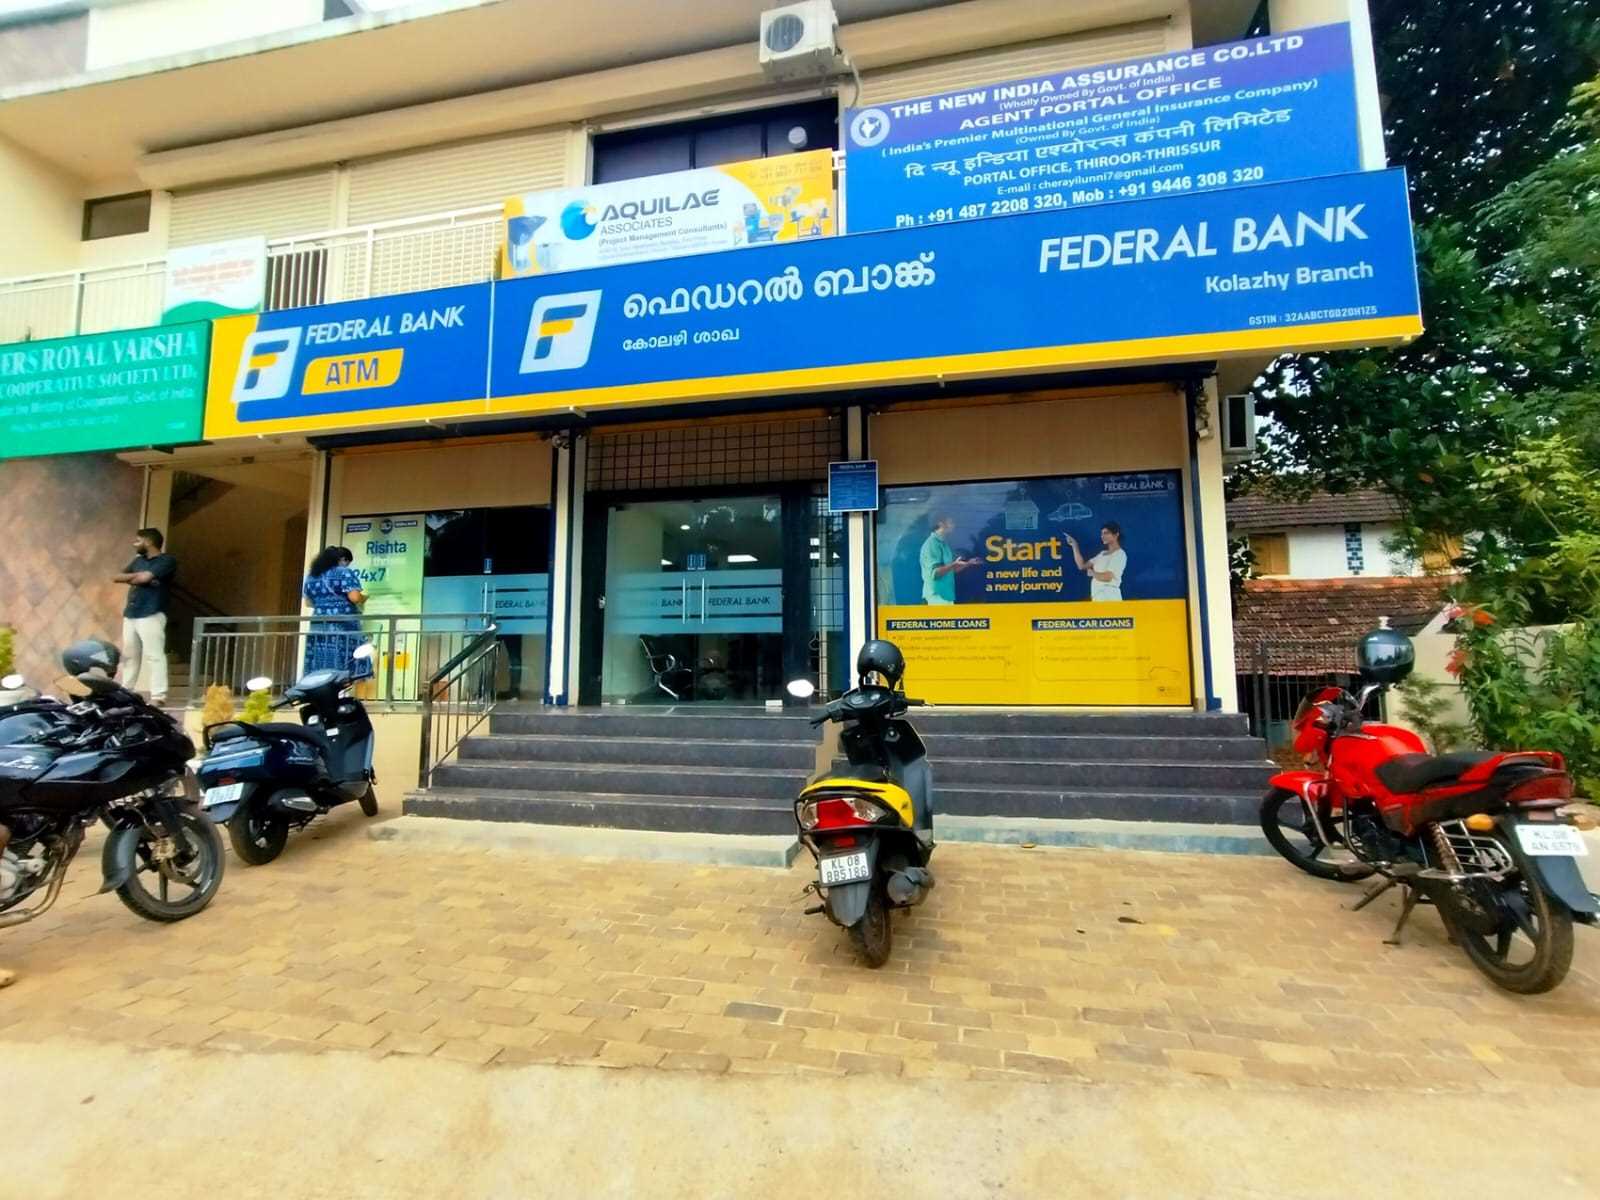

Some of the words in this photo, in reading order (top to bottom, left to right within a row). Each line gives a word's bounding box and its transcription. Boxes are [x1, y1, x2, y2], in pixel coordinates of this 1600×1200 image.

[891, 101, 933, 119] THE
[938, 91, 987, 111] NEW
[993, 80, 1055, 102] INDIA
[1061, 52, 1206, 90] ASSURANCE
[1213, 34, 1304, 63] CO.LTD
[959, 108, 1034, 130] AGENT
[1040, 93, 1130, 117] PORTAL
[1136, 77, 1222, 100] OFFICE
[999, 96, 1039, 112] (Wholly
[1041, 90, 1079, 104] Owned
[1082, 88, 1096, 98] By
[1098, 82, 1127, 94] Govt.
[1128, 77, 1141, 89] of
[1142, 73, 1175, 87] India)
[935, 133, 987, 149] Premier
[992, 116, 1088, 139] Multinational
[1092, 106, 1150, 125] General
[1155, 94, 1231, 113] Insurance
[1235, 78, 1318, 100] Company)
[1134, 120, 1196, 144] कंपनी
[1203, 107, 1295, 134] लिमिटेड
[1016, 131, 1060, 145] (Owned
[1062, 129, 1076, 139] By
[1079, 124, 1109, 135] Govt.
[1111, 120, 1125, 130] of
[1126, 115, 1160, 129] India)
[963, 165, 1016, 187] PORTAL
[1019, 161, 1073, 179] OFFICE,
[1075, 139, 1221, 171] THIROOR-THRISSUR
[895, 213, 915, 228] Ph
[927, 207, 954, 223] +91
[958, 203, 988, 219] 487
[991, 196, 1029, 215] 2208
[1033, 193, 1068, 209] 320,
[1072, 188, 1105, 206] Mob
[1118, 182, 1147, 198] +91
[1151, 175, 1193, 194] 9446
[1196, 172, 1228, 188] 308
[1232, 166, 1264, 183] 320
[997, 182, 1031, 196] E-mail
[600, 188, 721, 222] AQUILAE
[600, 216, 674, 236] ASSOCIATES
[628, 229, 678, 243] Management
[677, 222, 729, 237] Consultants)
[1039, 220, 1218, 273] FEDERAL
[1231, 202, 1369, 255] BANK
[622, 264, 805, 321] ഫെഡറൽ
[813, 251, 937, 299] ബാങ്ക്
[1205, 270, 1290, 294] Kolazhy
[1295, 260, 1374, 286] Branch
[305, 314, 393, 346] FEDERAL
[399, 304, 466, 335] BANK
[1248, 314, 1277, 327] GSTIN
[42, 339, 108, 373] ROYAL
[112, 330, 199, 365] VARSHA
[622, 329, 689, 353] കോലഴി
[693, 326, 740, 346] ശാഖ
[98, 366, 159, 388] SOCIETY
[325, 357, 379, 386] ATM
[1104, 481, 1138, 492] FEDERAL
[1139, 479, 1164, 490] BANK
[366, 540, 407, 556] Rishta
[985, 534, 1062, 563] Start
[986, 570, 994, 579] a
[995, 570, 1019, 579] new
[1022, 567, 1038, 579] life
[1041, 566, 1063, 579] and
[985, 584, 993, 592] a
[995, 583, 1019, 592] new
[1020, 580, 1064, 595] journey
[708, 598, 743, 608] FEDERAL
[744, 597, 771, 606] BANK
[891, 620, 928, 630] FEDERAL
[930, 620, 956, 629] HOME
[958, 619, 987, 629] LOANS
[1038, 620, 1077, 629] FEDERAL
[1078, 619, 1098, 629] CAR
[1099, 619, 1131, 628] LOANS
[831, 859, 844, 871] KL
[847, 855, 860, 867] 08
